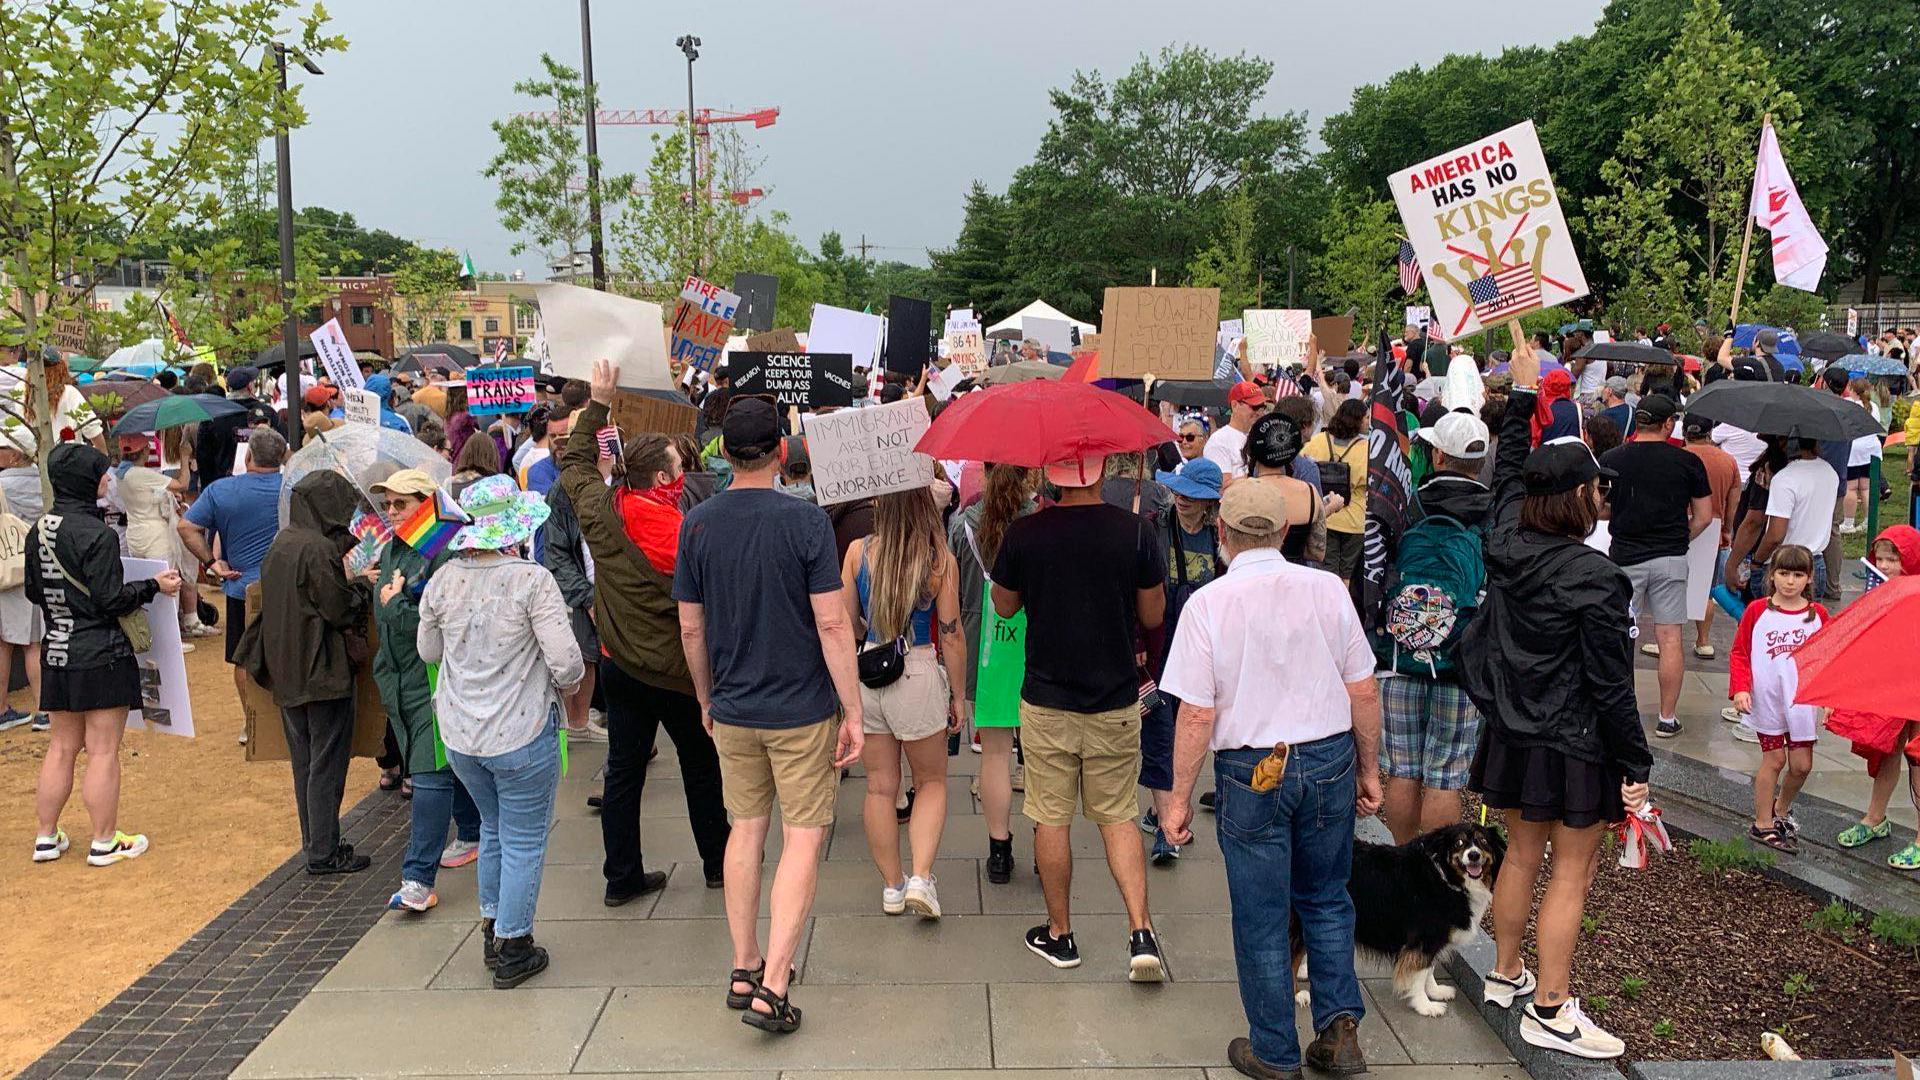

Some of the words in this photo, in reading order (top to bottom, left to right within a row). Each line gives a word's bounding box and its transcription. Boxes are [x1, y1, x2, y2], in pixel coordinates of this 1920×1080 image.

[1409, 140, 1514, 194] AMERICA
[1431, 178, 1476, 208] HAS
[1485, 162, 1518, 188] NO
[1433, 178, 1552, 242] KINGS
[685, 277, 720, 300] FIRE
[701, 297, 735, 320] ICE
[1136, 290, 1214, 322] POWER
[319, 338, 346, 392] ONSTITUTION
[766, 354, 811, 368] SCIENCE
[1131, 343, 1211, 374] PEOPLE
[471, 369, 523, 385] PROTECT
[734, 365, 761, 389] RESEARCH
[765, 368, 790, 379] KEEPS
[790, 369, 813, 380] YOUR
[766, 380, 792, 390] DUMB
[793, 381, 811, 390] ASS
[824, 369, 852, 390] VACCINES
[471, 381, 526, 399] TRANS
[776, 391, 809, 404] ALIVE
[480, 397, 522, 410] LIVES
[813, 405, 928, 442] IMMIGRANTS
[837, 440, 871, 457] ARE
[876, 426, 913, 449] NOT
[818, 458, 863, 478] YOUR
[820, 468, 912, 500] IGNORANCE
[994, 620, 1018, 643] fix
[1765, 630, 1790, 646] Got
